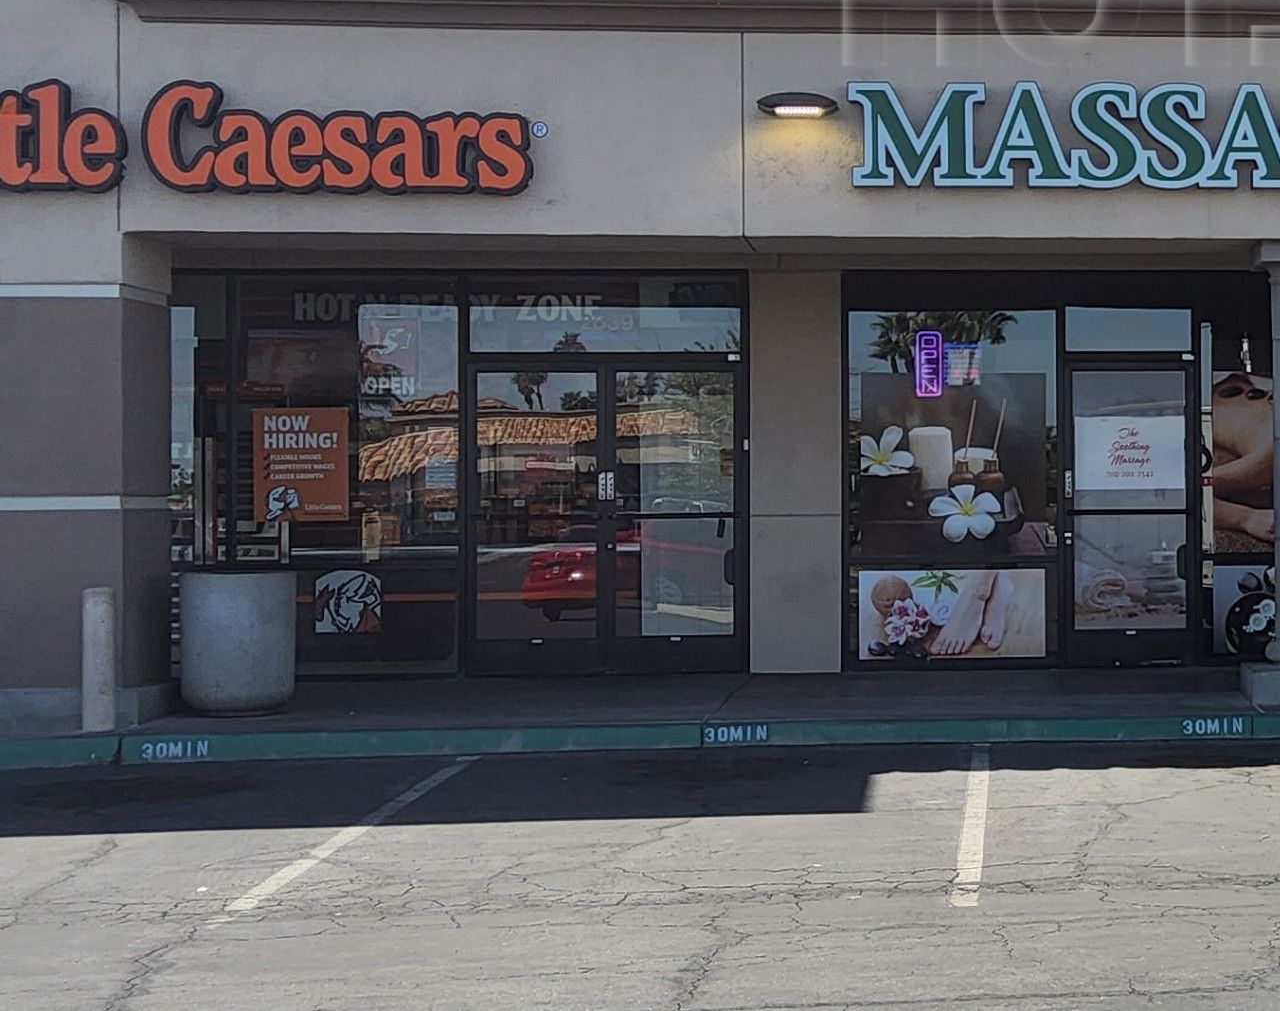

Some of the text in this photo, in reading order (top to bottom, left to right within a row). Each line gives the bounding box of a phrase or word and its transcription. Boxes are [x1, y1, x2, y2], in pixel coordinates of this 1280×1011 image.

[141, 78, 536, 195] Caesars
[294, 292, 353, 322] HOT
[516, 294, 603, 322] ZONE
[920, 335, 938, 393] OPEN
[365, 376, 415, 395] OPEN
[263, 414, 311, 433] NOW
[1118, 426, 1140, 440] The
[263, 431, 339, 450] HIRING!
[1107, 454, 1152, 469] Massage
[704, 724, 770, 743] 30MIN
[1182, 717, 1246, 736] 30MIN
[142, 739, 210, 760] 30MIN
